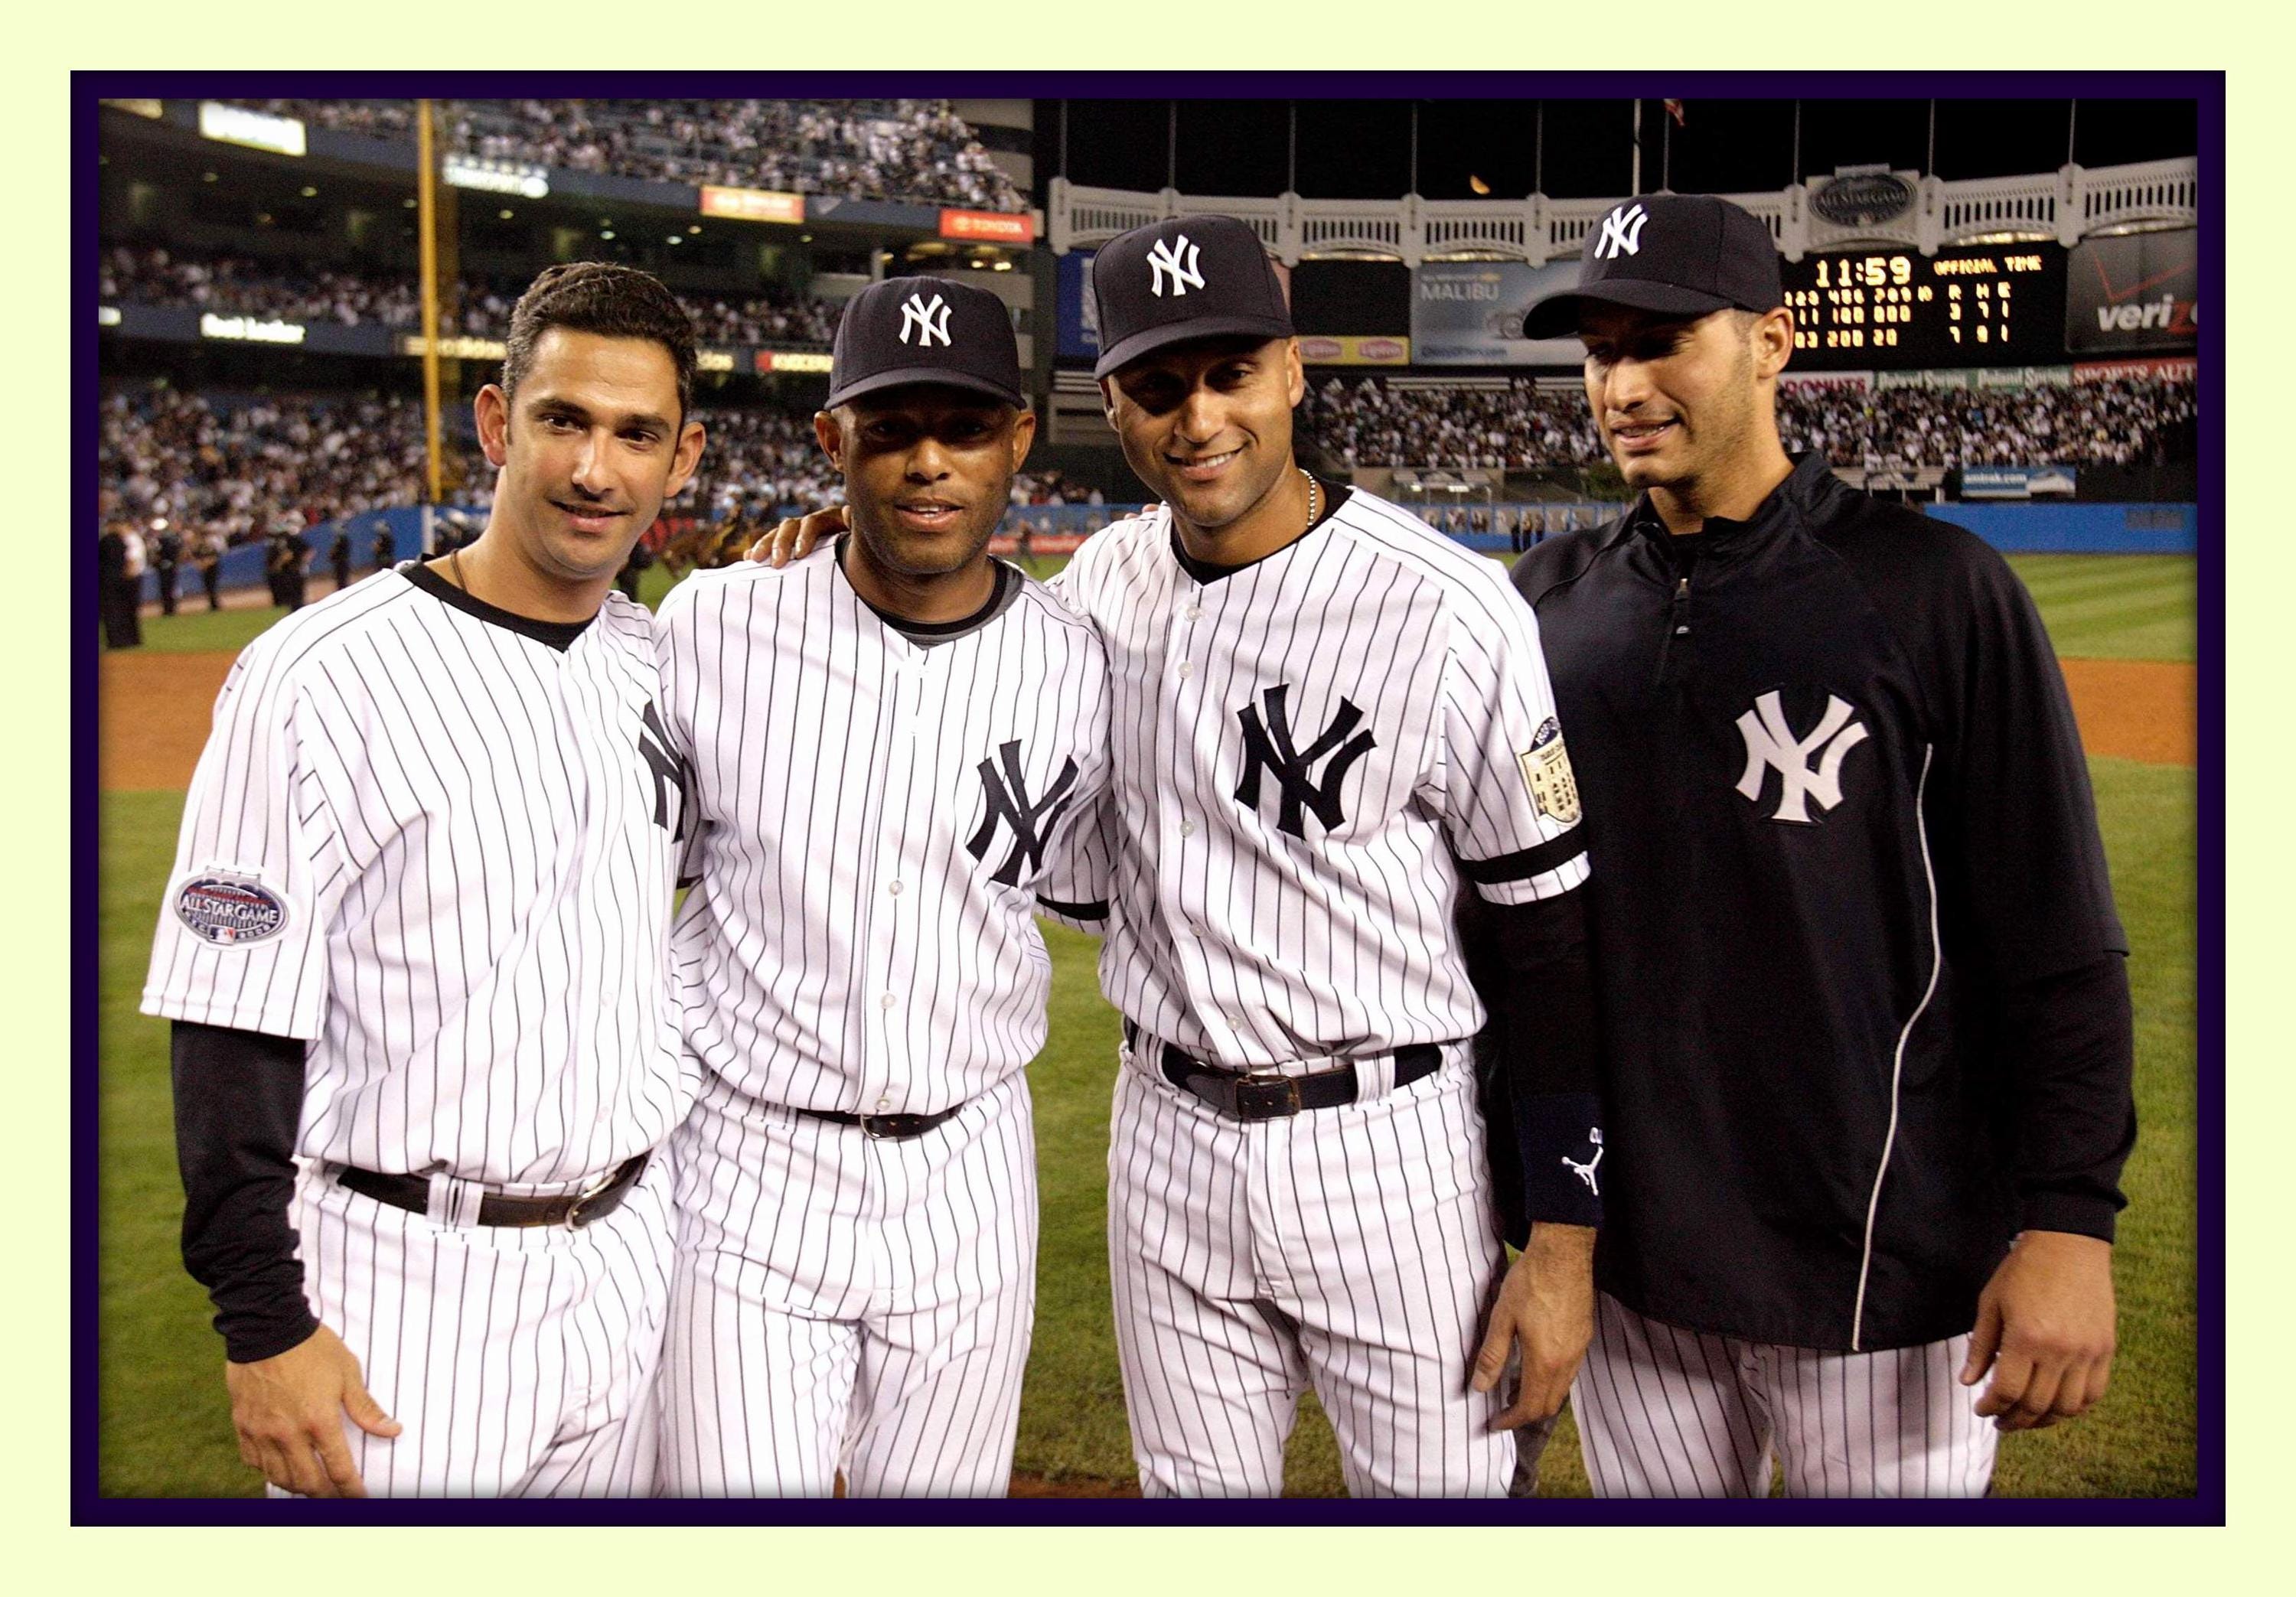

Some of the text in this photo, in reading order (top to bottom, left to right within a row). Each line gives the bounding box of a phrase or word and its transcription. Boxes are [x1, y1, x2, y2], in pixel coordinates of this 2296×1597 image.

[1594, 204, 1648, 259] NY
[1146, 234, 1205, 298] NY
[1421, 283, 1499, 301] MALIBU
[1816, 255, 2042, 288] 11:59 OFFICIAL TIME
[899, 293, 952, 347] NY
[1234, 683, 1378, 841] NY
[1735, 690, 1870, 823] NY
[966, 738, 1079, 888] NY
[234, 904, 279, 924] GAME
